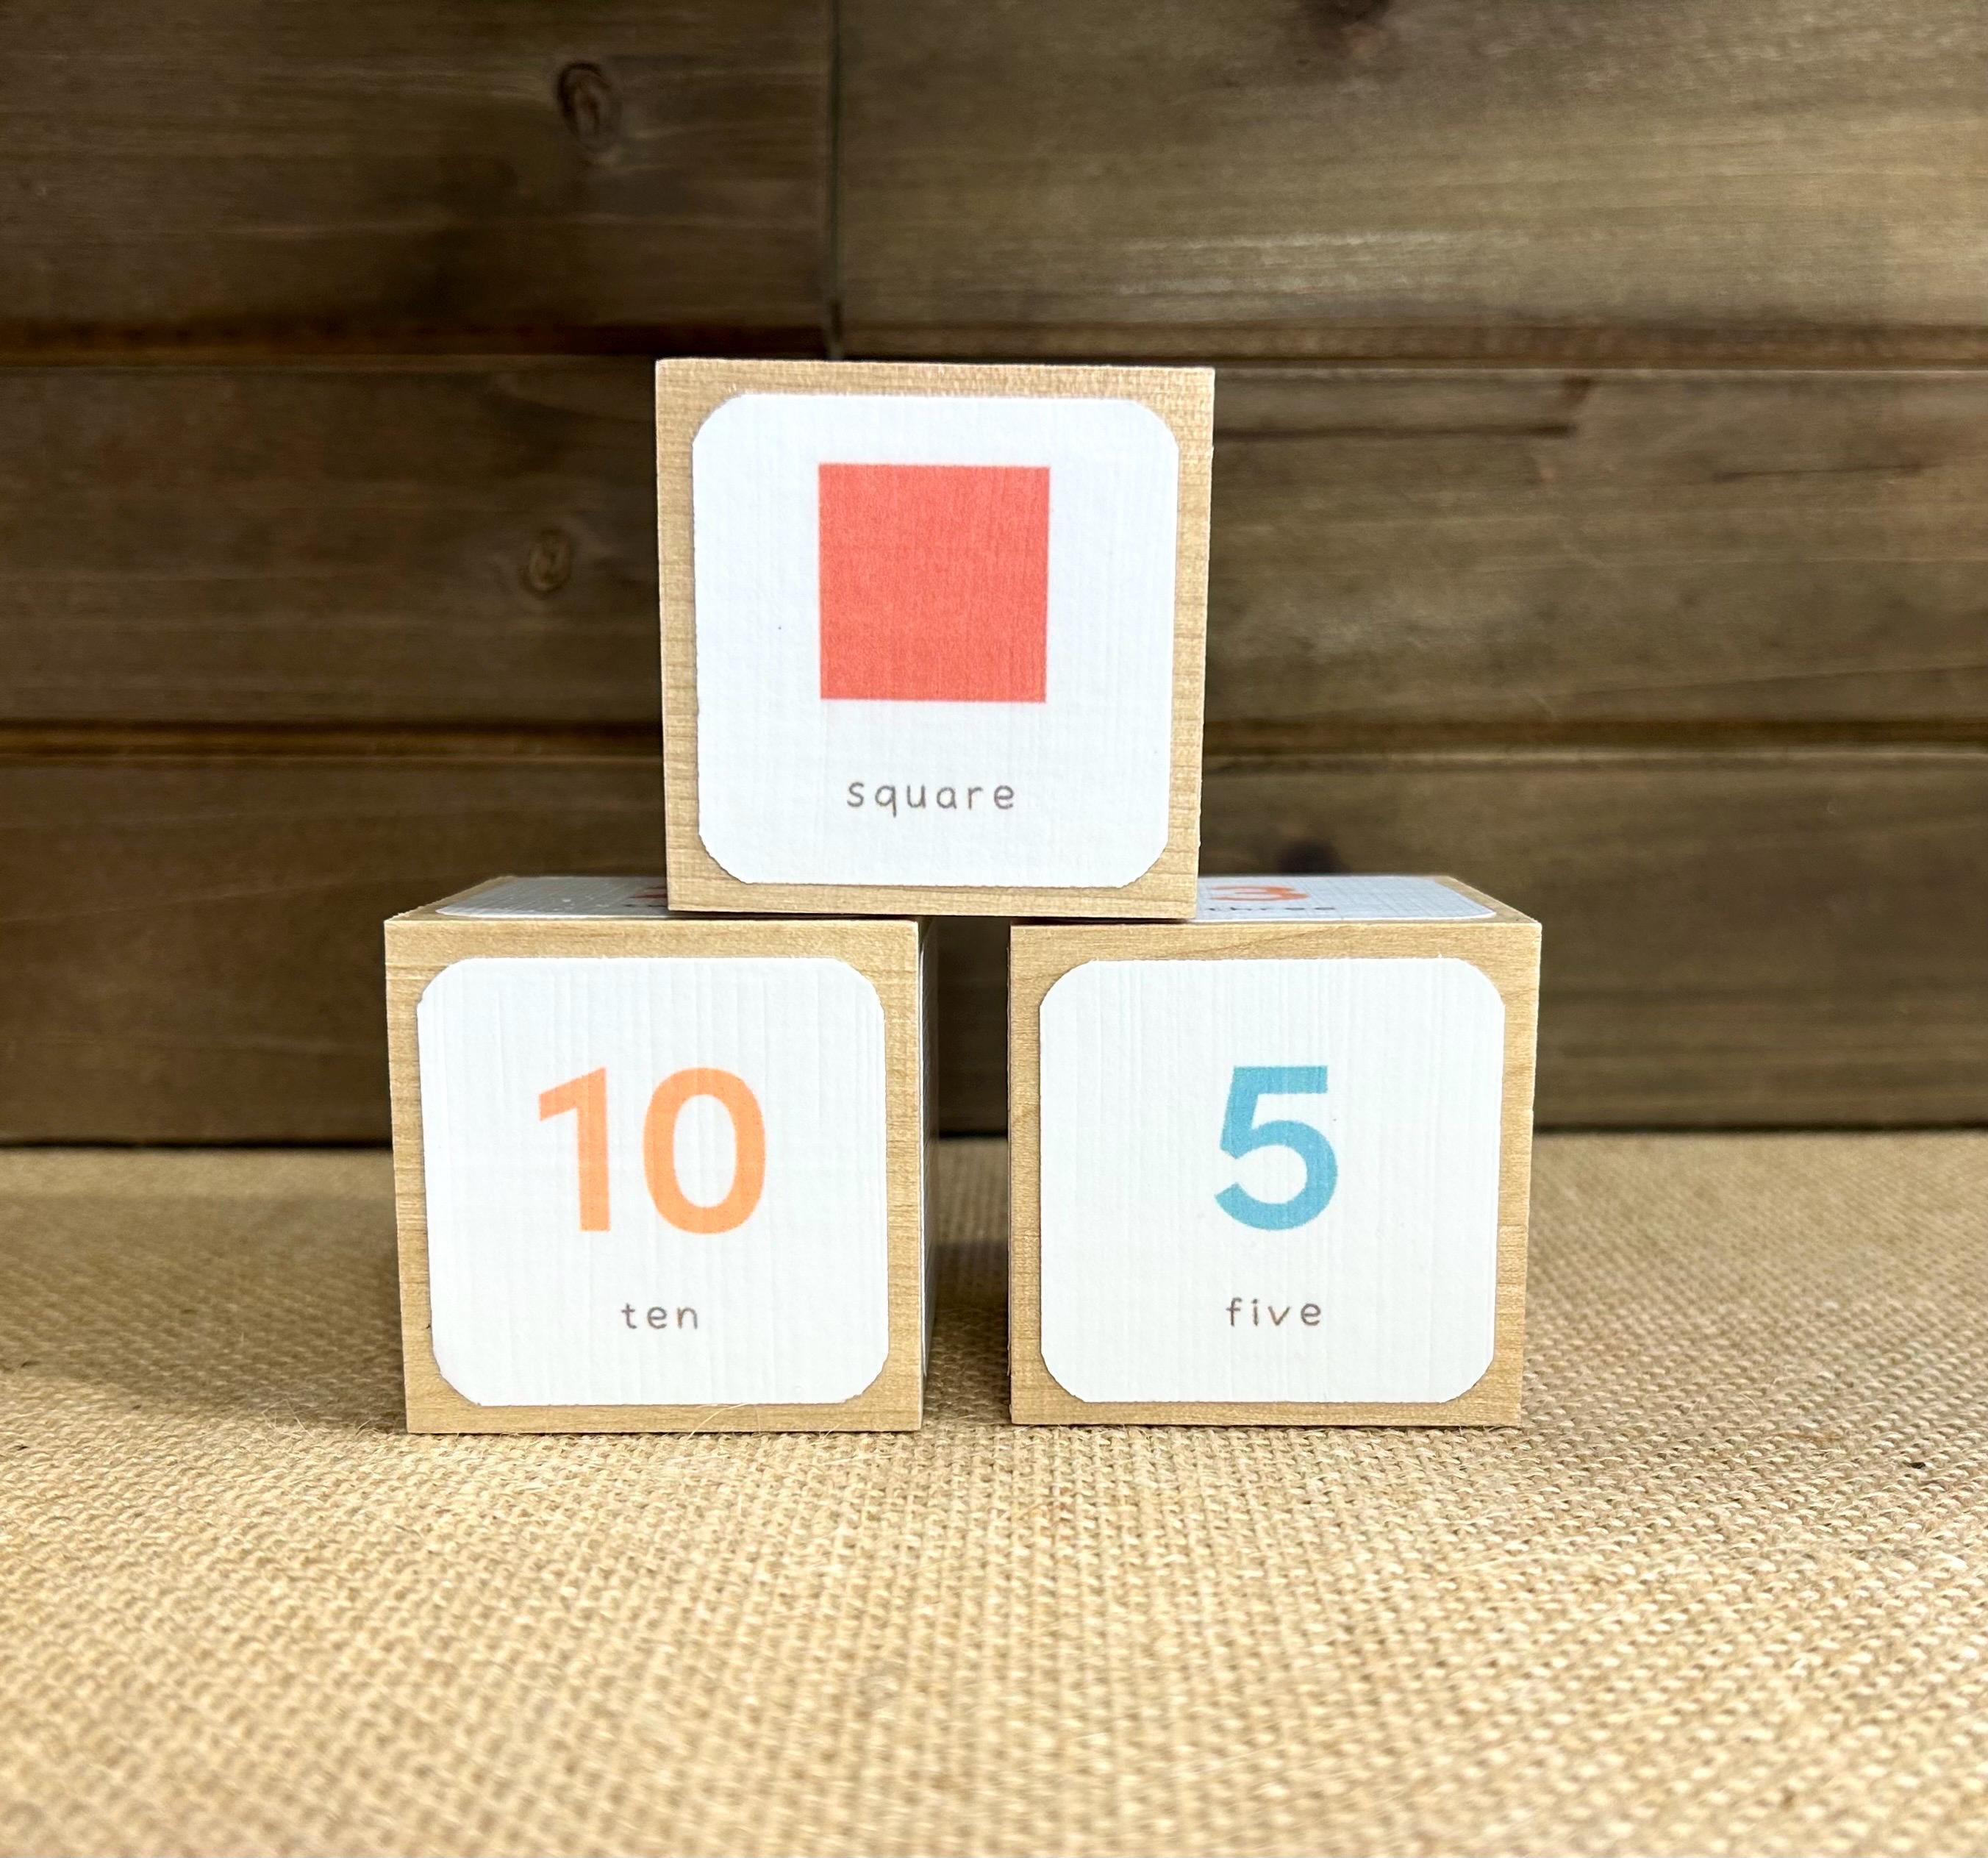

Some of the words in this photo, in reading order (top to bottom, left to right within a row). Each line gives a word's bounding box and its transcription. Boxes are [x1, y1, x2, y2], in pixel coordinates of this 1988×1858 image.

[846, 782, 1015, 818] square
[1210, 885, 1310, 902] 3
[539, 1067, 766, 1235] 10
[1215, 1065, 1337, 1229] 5
[621, 1302, 698, 1330] ten
[1226, 1297, 1322, 1327] five
